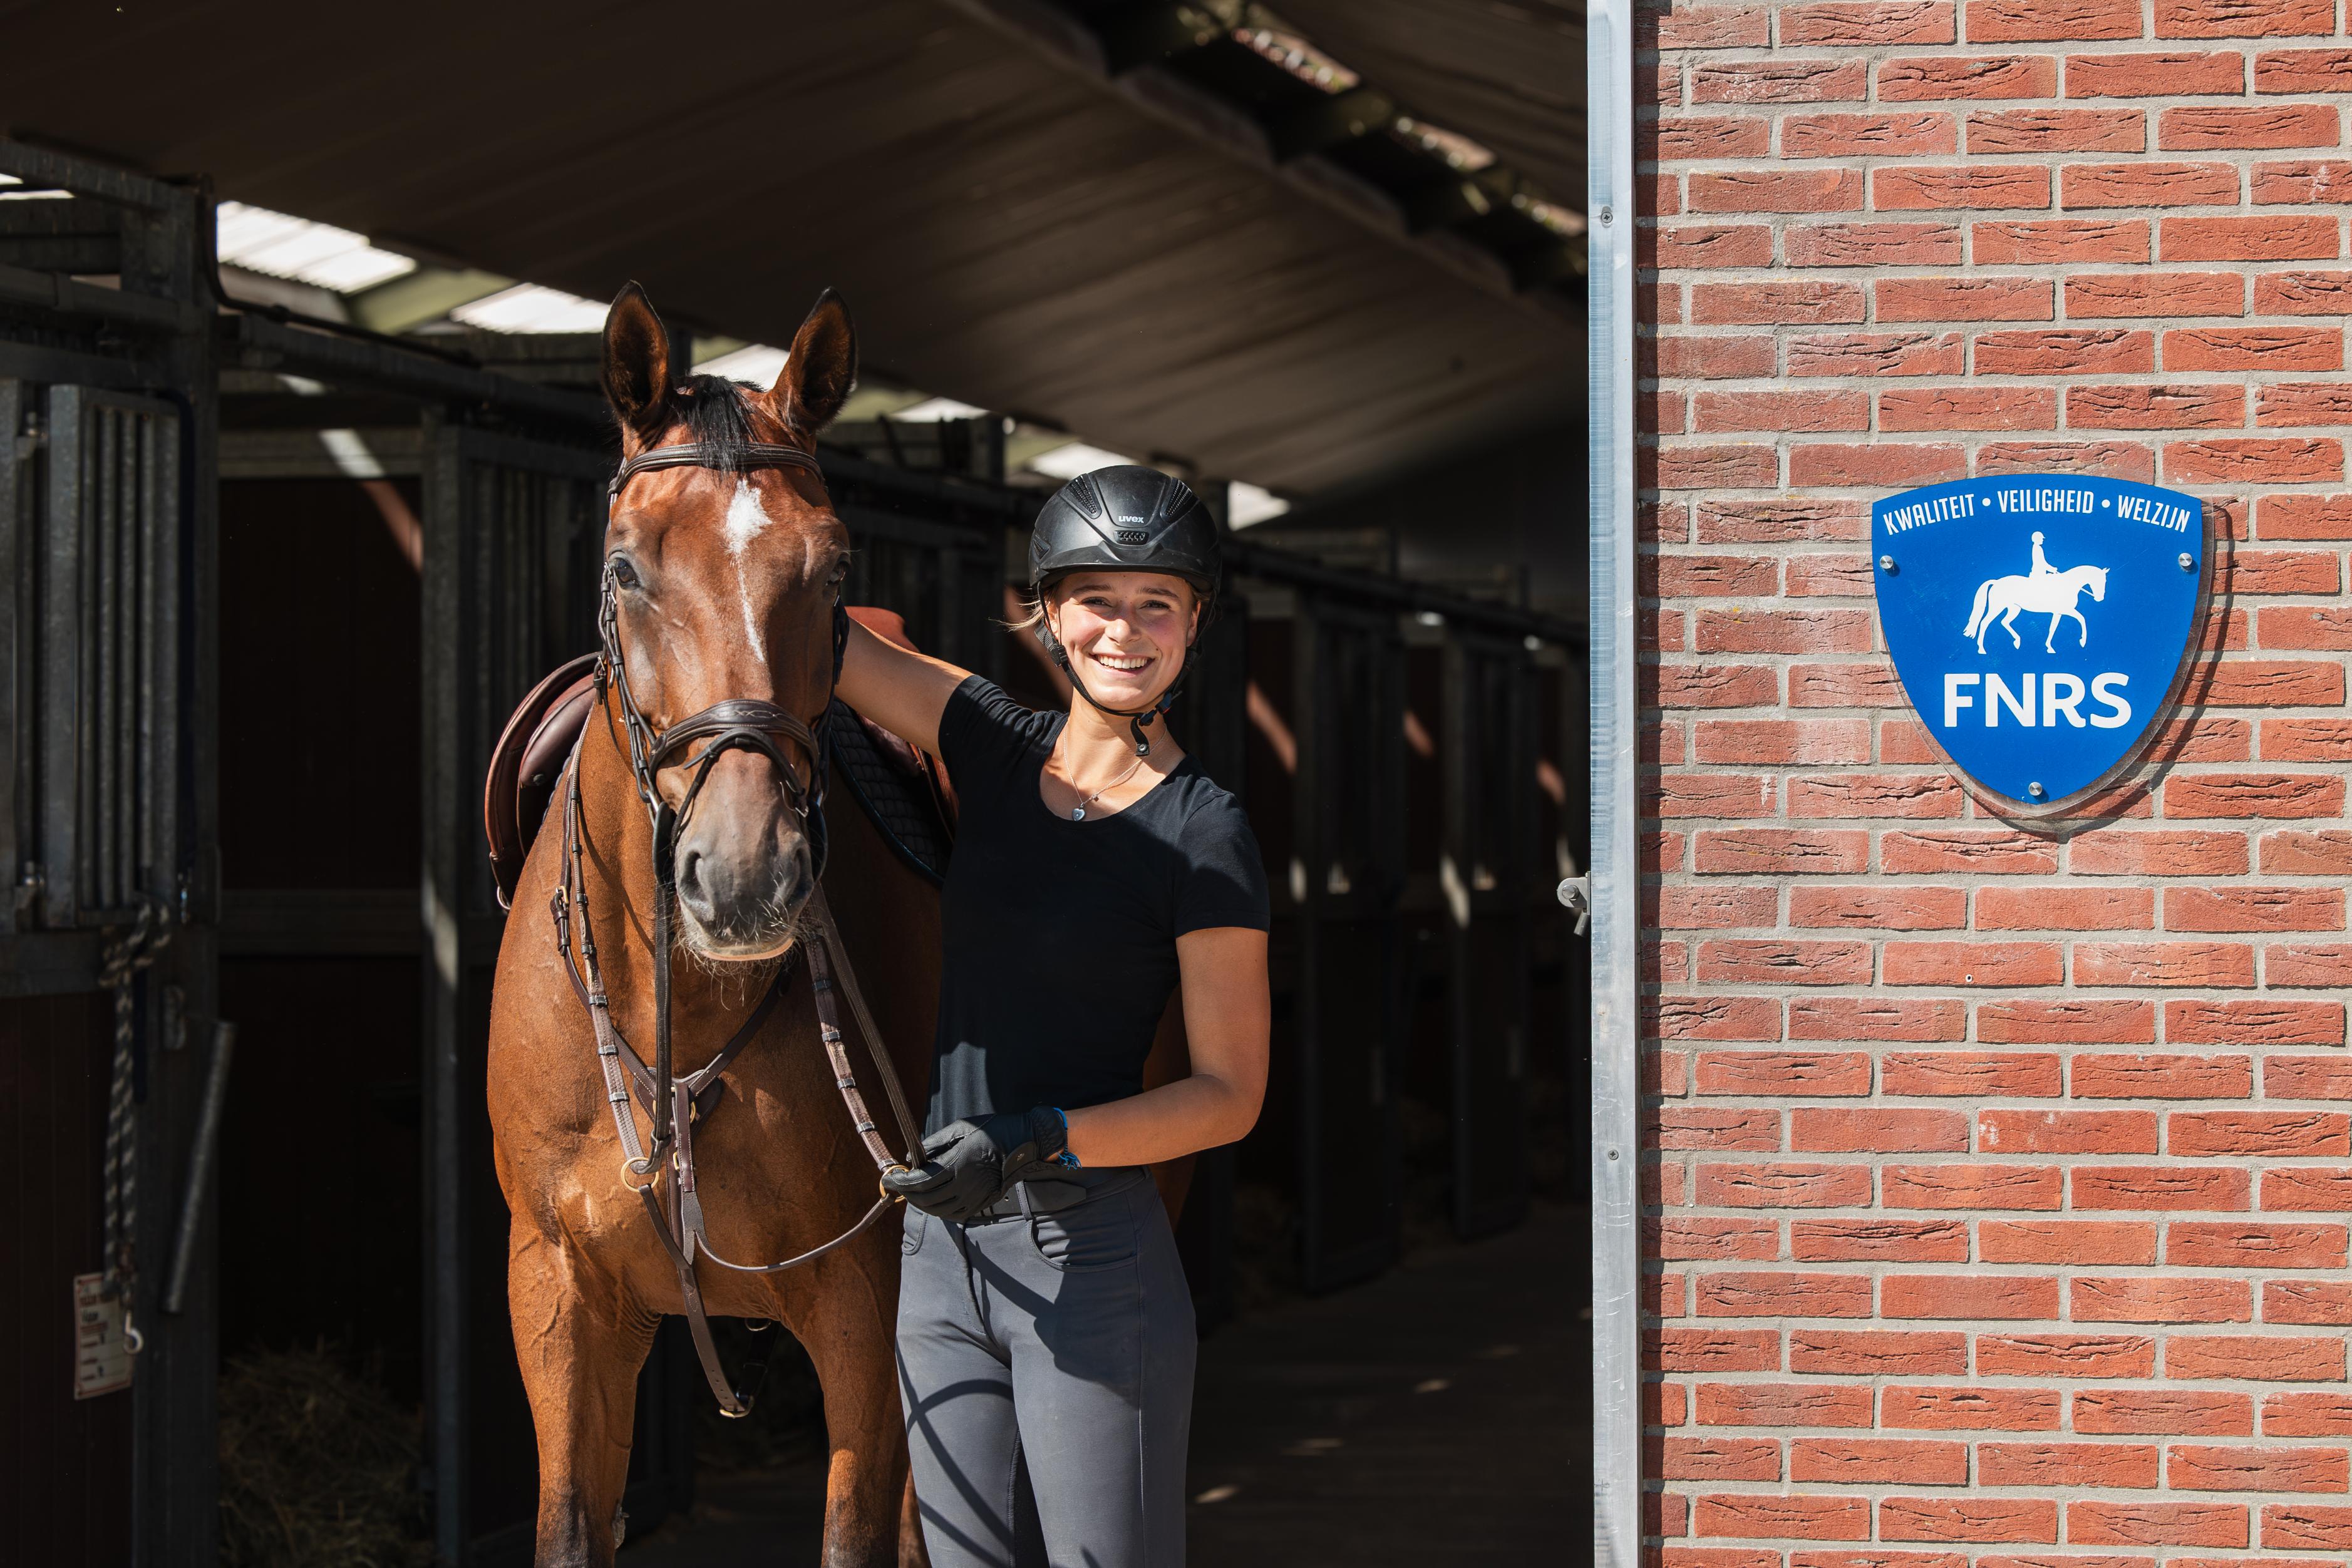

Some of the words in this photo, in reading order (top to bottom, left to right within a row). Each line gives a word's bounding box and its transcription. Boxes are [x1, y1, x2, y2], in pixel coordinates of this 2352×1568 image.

[1118, 515, 1145, 524] uvex
[1882, 493, 1974, 535] KWALITEIT
[1997, 489, 2094, 514] VEILIGHEID
[2117, 494, 2191, 534] WELZIJN
[1944, 672, 2132, 729] FNRS
